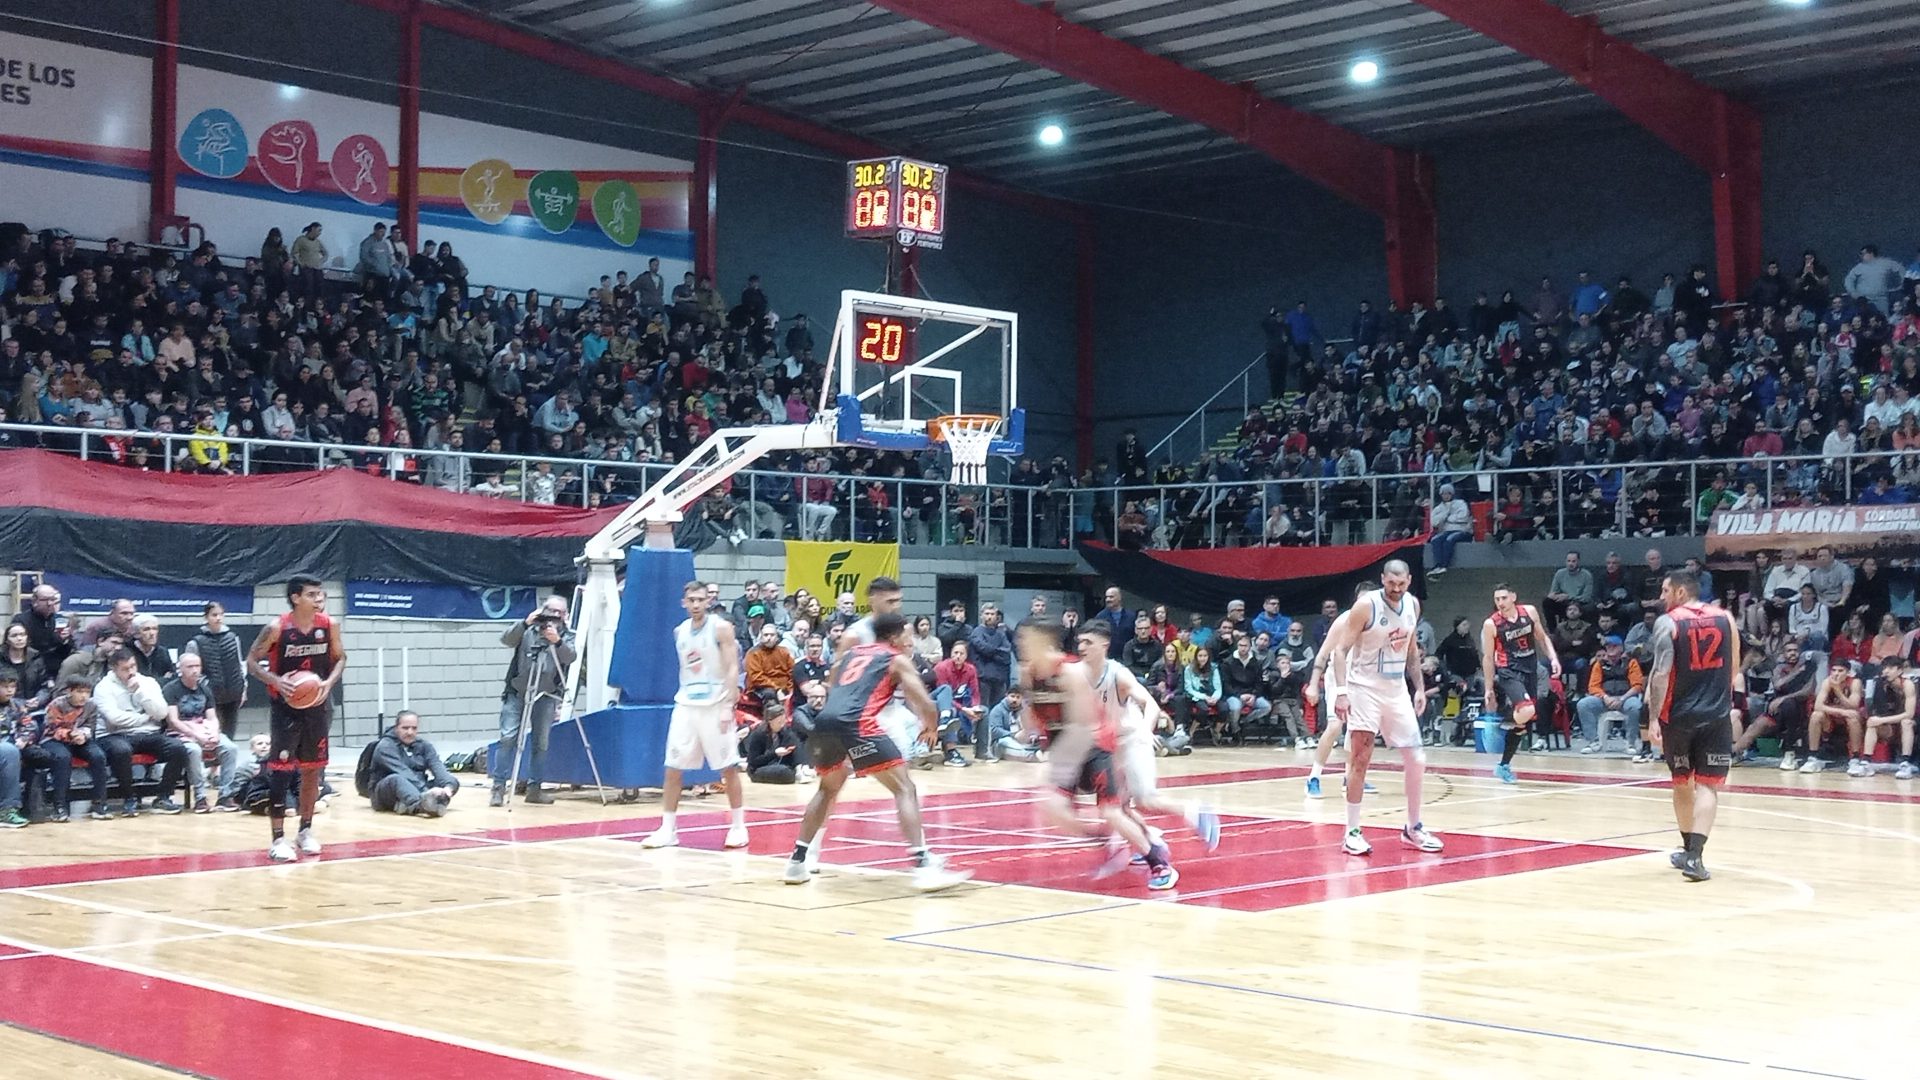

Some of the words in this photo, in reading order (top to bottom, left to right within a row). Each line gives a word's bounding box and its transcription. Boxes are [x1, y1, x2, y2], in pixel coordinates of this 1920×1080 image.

[29, 62, 76, 88] LOS
[855, 164, 885, 187] 30.2
[903, 164, 932, 190] 30.2
[861, 322, 902, 361] 20
[1718, 513, 1772, 535] VILLA
[1776, 508, 1856, 533] MARÍA
[1687, 626, 1723, 671] 12
[839, 655, 874, 687] 8
